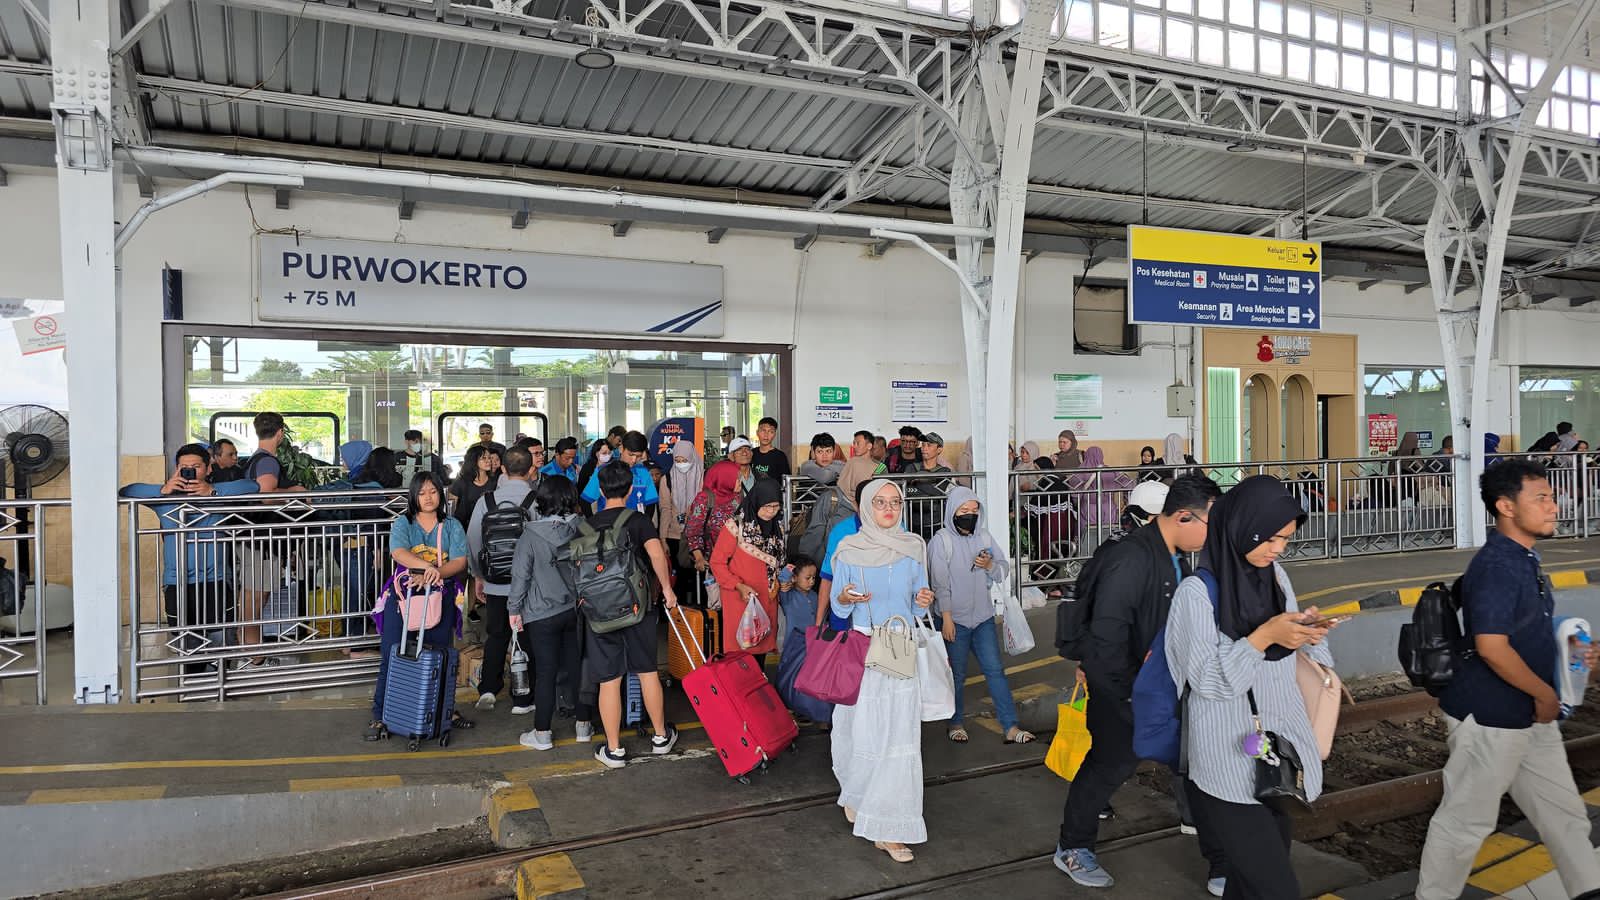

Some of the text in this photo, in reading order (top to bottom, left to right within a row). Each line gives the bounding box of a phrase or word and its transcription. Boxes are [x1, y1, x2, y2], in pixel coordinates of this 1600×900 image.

[282, 251, 528, 290] PURWOKERTO
[1136, 266, 1190, 279] Pos Kesehatan
[1218, 272, 1244, 282] Musala
[1266, 275, 1285, 285] Toilet
[1154, 279, 1175, 287] Medical
[1211, 281, 1229, 290] Praying
[303, 290, 328, 306] 75
[335, 290, 356, 307] M
[1178, 301, 1217, 311] Keamanan
[1236, 304, 1285, 314] Area Merokok
[1196, 313, 1216, 321] Security
[1250, 315, 1271, 323] Smoking
[829, 411, 840, 419] 121
